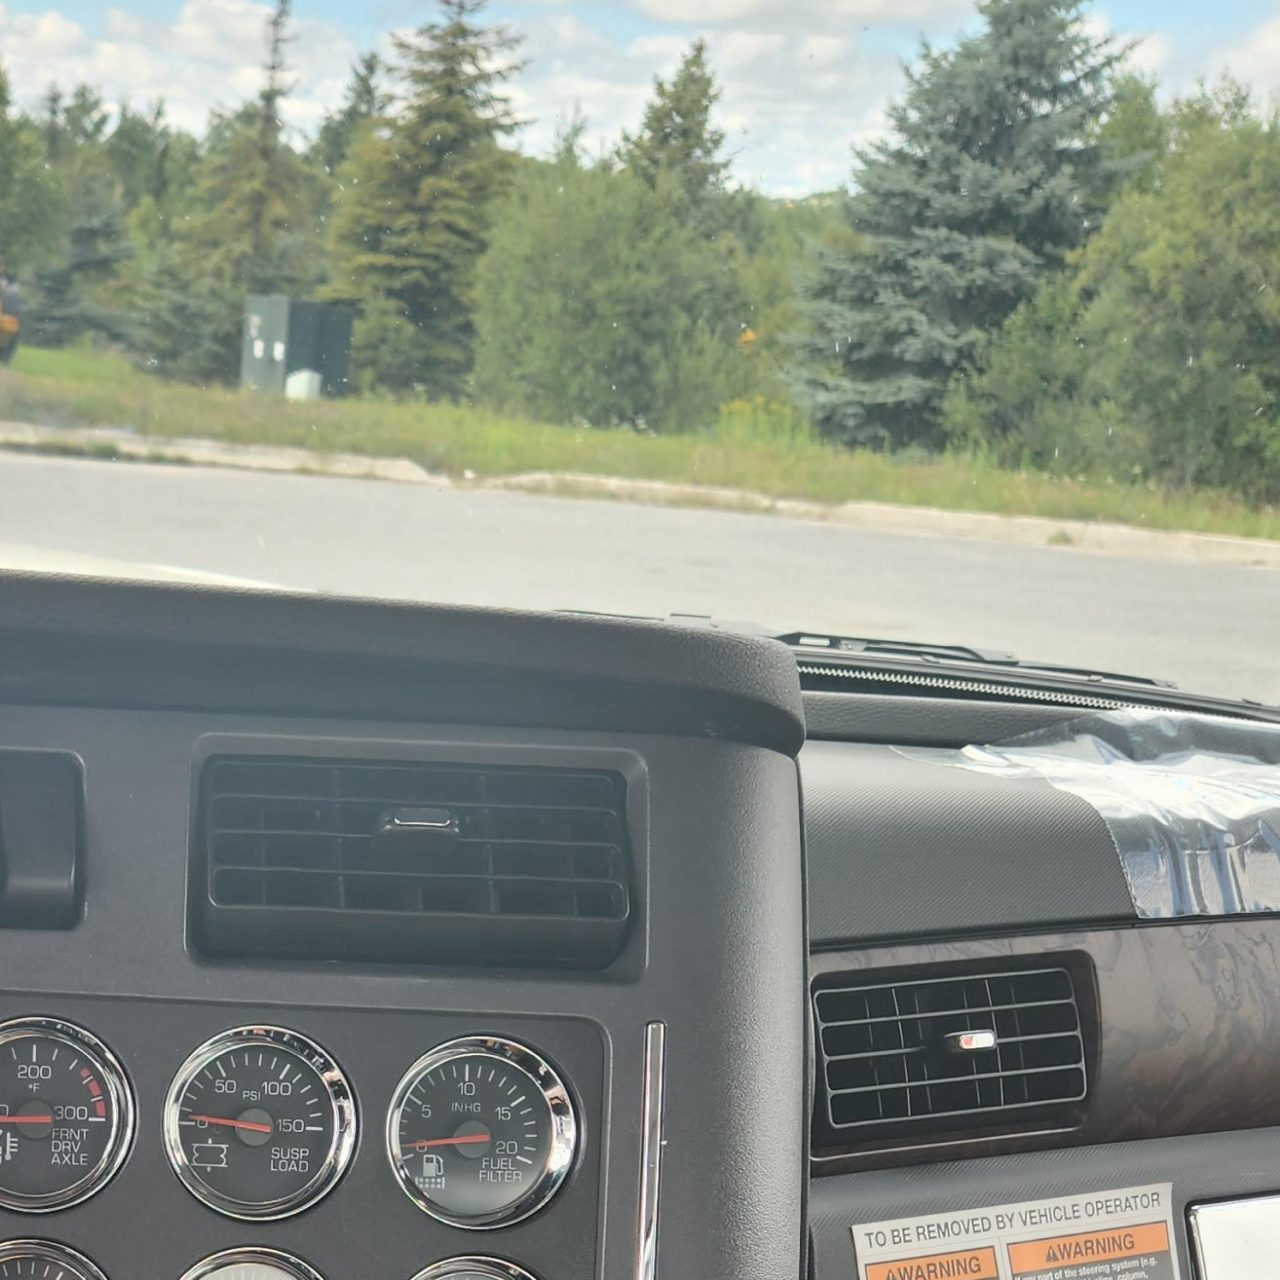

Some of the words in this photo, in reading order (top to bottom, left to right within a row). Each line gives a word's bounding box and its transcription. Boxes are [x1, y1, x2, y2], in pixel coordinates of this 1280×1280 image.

[18, 1066, 52, 1079] 200
[215, 1080, 236, 1093] 50
[262, 1081, 292, 1095] 100
[457, 1083, 475, 1096] 10
[243, 1091, 260, 1100] PSI
[55, 1107, 87, 1120] 300
[421, 1106, 431, 1118] 5
[495, 1107, 511, 1121] 15
[277, 1119, 304, 1132] 150
[52, 1129, 89, 1139] FRNT
[52, 1141, 81, 1152] DRV
[271, 1147, 309, 1159] SUSP
[496, 1141, 518, 1154] 20
[51, 1154, 88, 1165] AXLE
[271, 1160, 308, 1172] LOAD
[482, 1159, 516, 1170] FUEL
[479, 1170, 522, 1182] FILTER
[865, 1232, 886, 1248] TO
[892, 1227, 912, 1245] BE
[916, 1217, 991, 1243] REMOVED
[997, 1214, 1014, 1229] BY
[1019, 1204, 1079, 1227] VEHICLE
[1085, 1192, 1160, 1217] OPERATOR
[1057, 1234, 1134, 1260] WARNING
